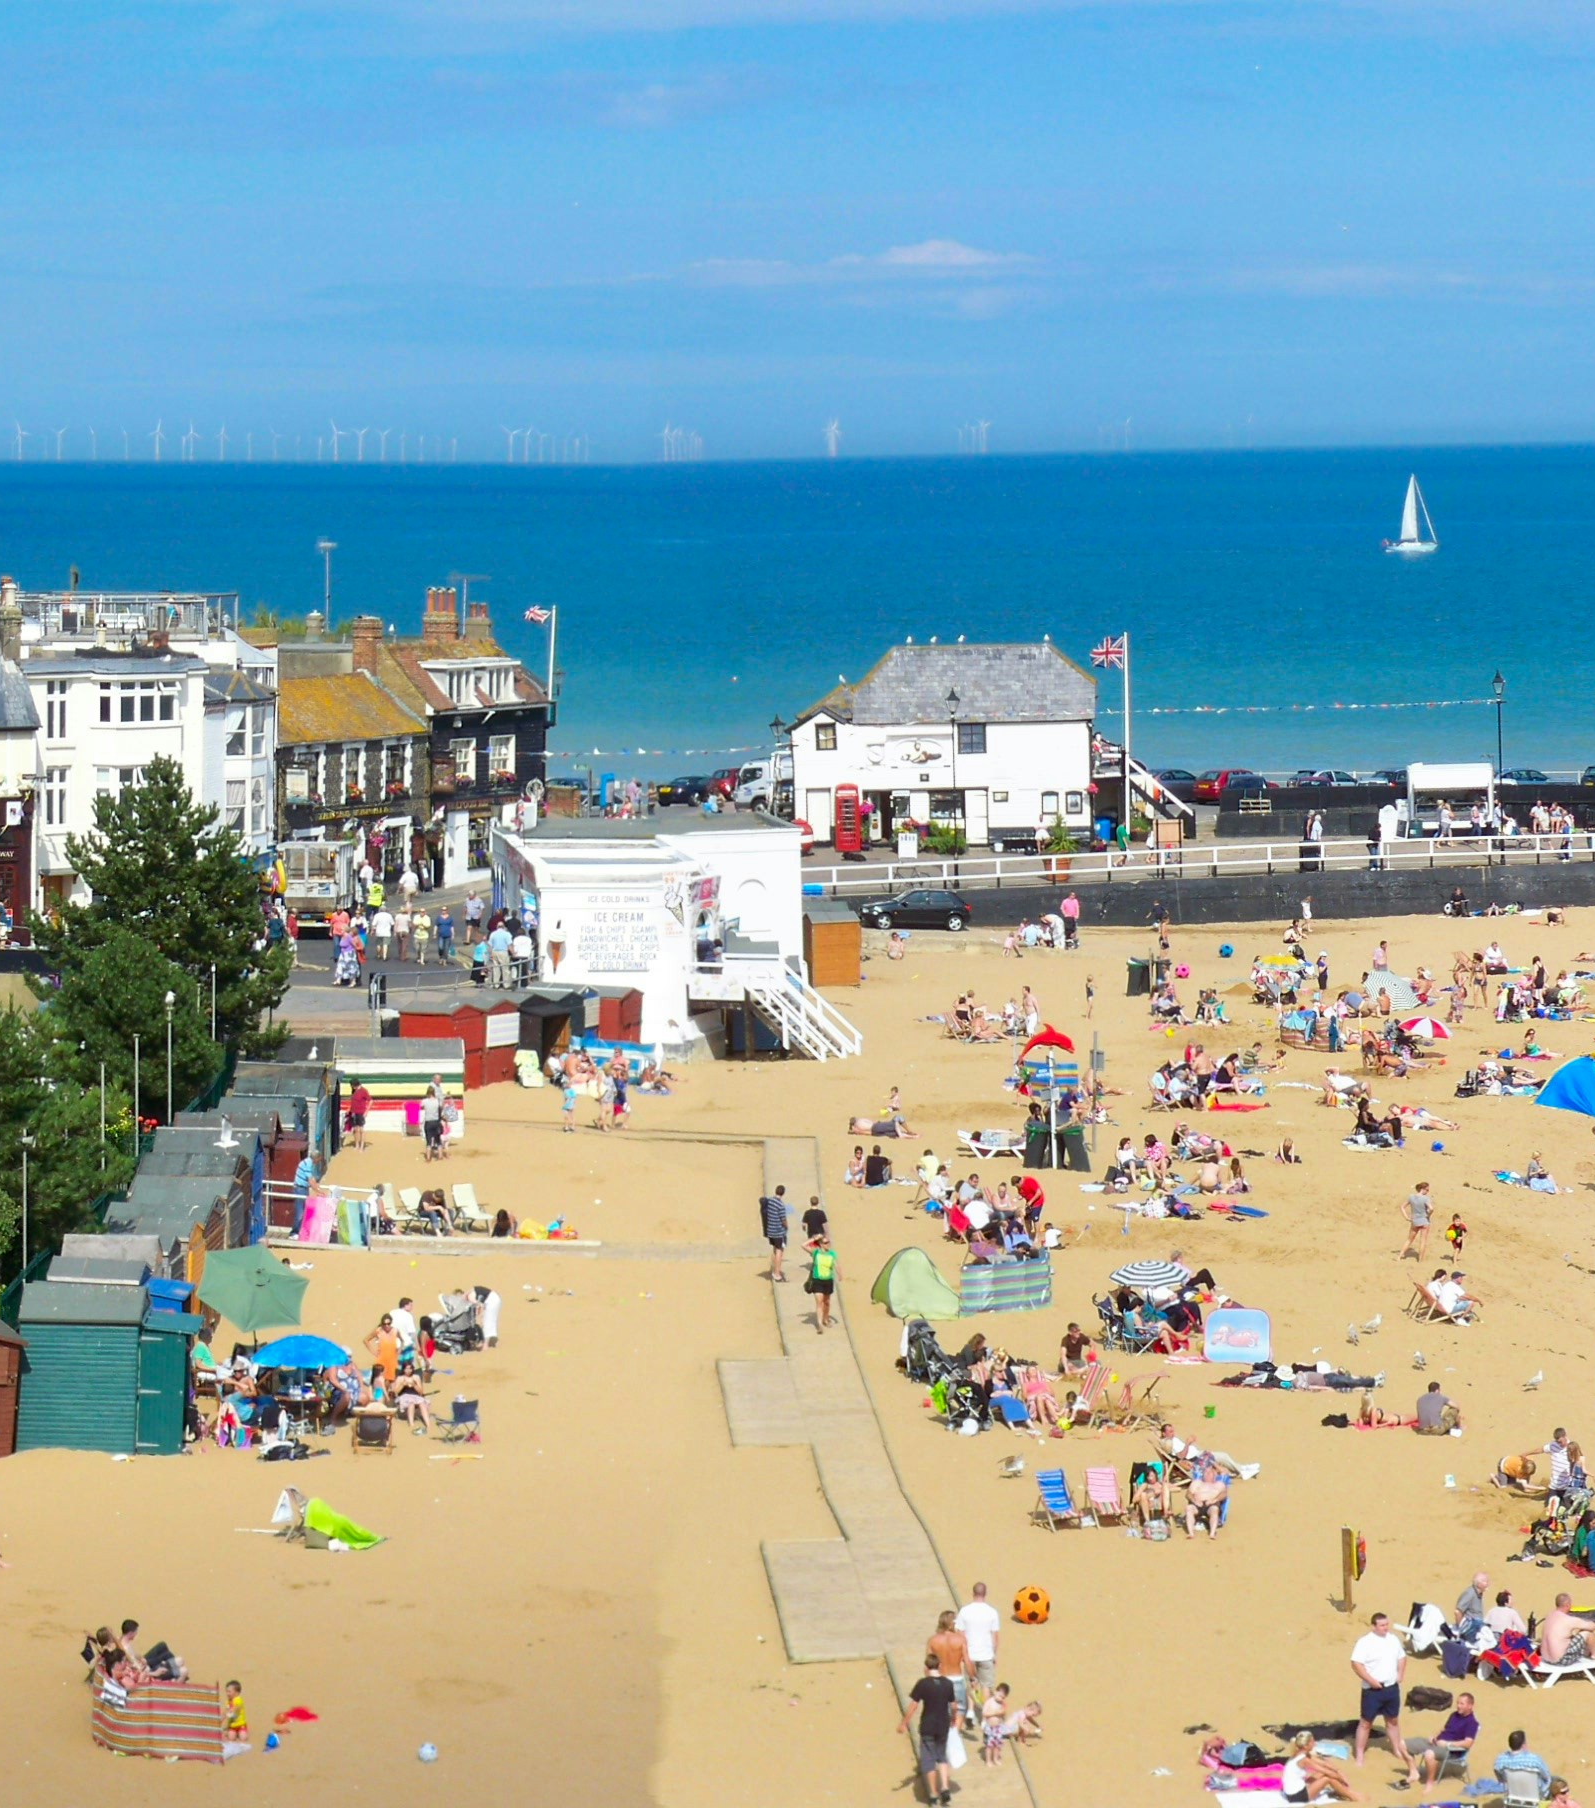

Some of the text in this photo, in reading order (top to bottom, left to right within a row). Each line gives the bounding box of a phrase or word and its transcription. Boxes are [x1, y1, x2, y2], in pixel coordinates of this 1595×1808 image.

[594, 912, 644, 923] ICE CREAM
[580, 926, 596, 934] FISH
[606, 926, 626, 934] CHIPS
[579, 935, 659, 943] SANDWICHES CHICKEN
[577, 944, 660, 952] BURGERS PIZZA CHIPS
[579, 953, 657, 961] HOT BEVERAGES ROCK
[589, 961, 647, 970] ICE COLD DRINKS
